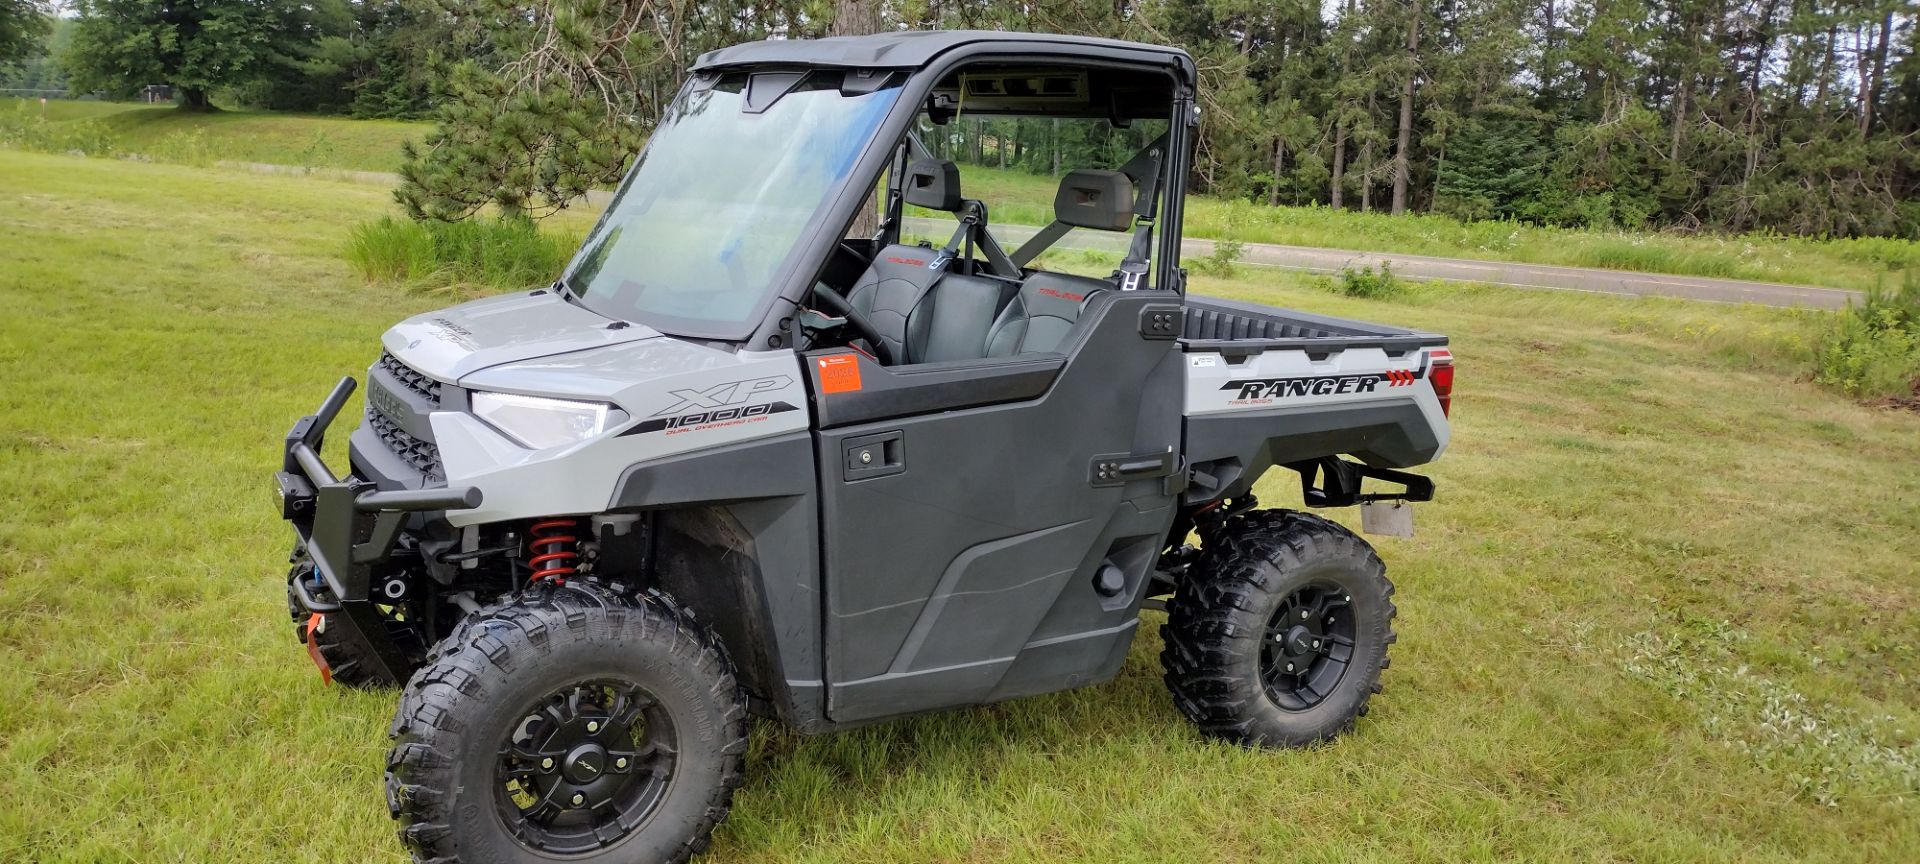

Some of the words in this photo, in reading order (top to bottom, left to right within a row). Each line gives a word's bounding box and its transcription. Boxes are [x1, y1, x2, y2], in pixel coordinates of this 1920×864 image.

[650, 374, 795, 417] XP
[1236, 375, 1381, 400] RANGER
[664, 401, 772, 430] 1000
[665, 427, 692, 436] DUAL
[694, 420, 746, 431] OVERHEAD
